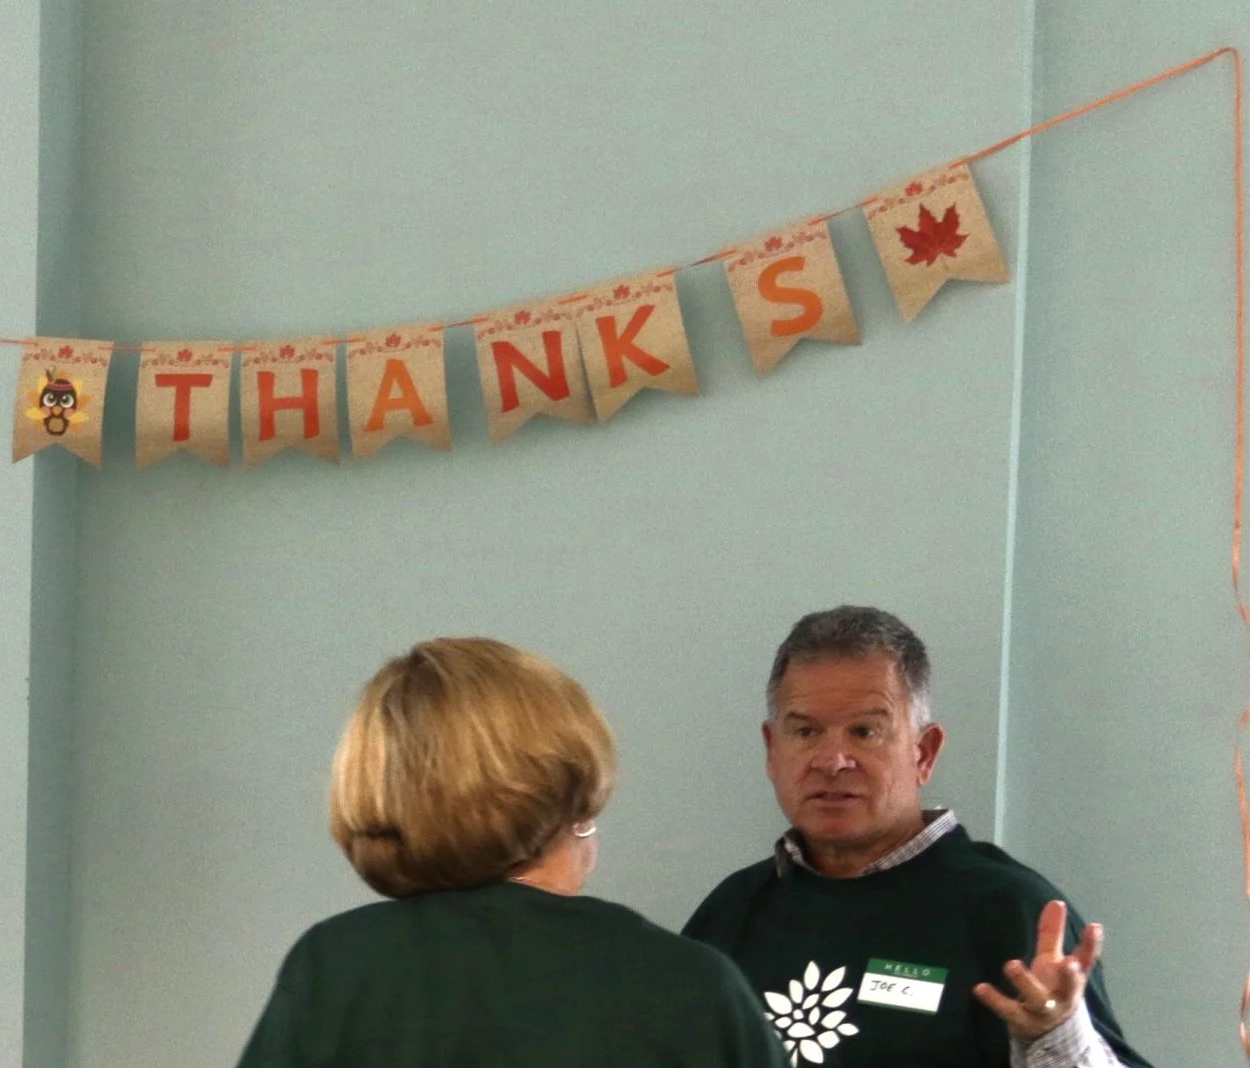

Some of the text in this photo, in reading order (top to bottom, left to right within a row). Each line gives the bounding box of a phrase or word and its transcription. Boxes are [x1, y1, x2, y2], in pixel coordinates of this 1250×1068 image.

[156, 256, 824, 442] THANKS
[883, 963, 931, 977] HELLO
[869, 980, 897, 993] JOE
